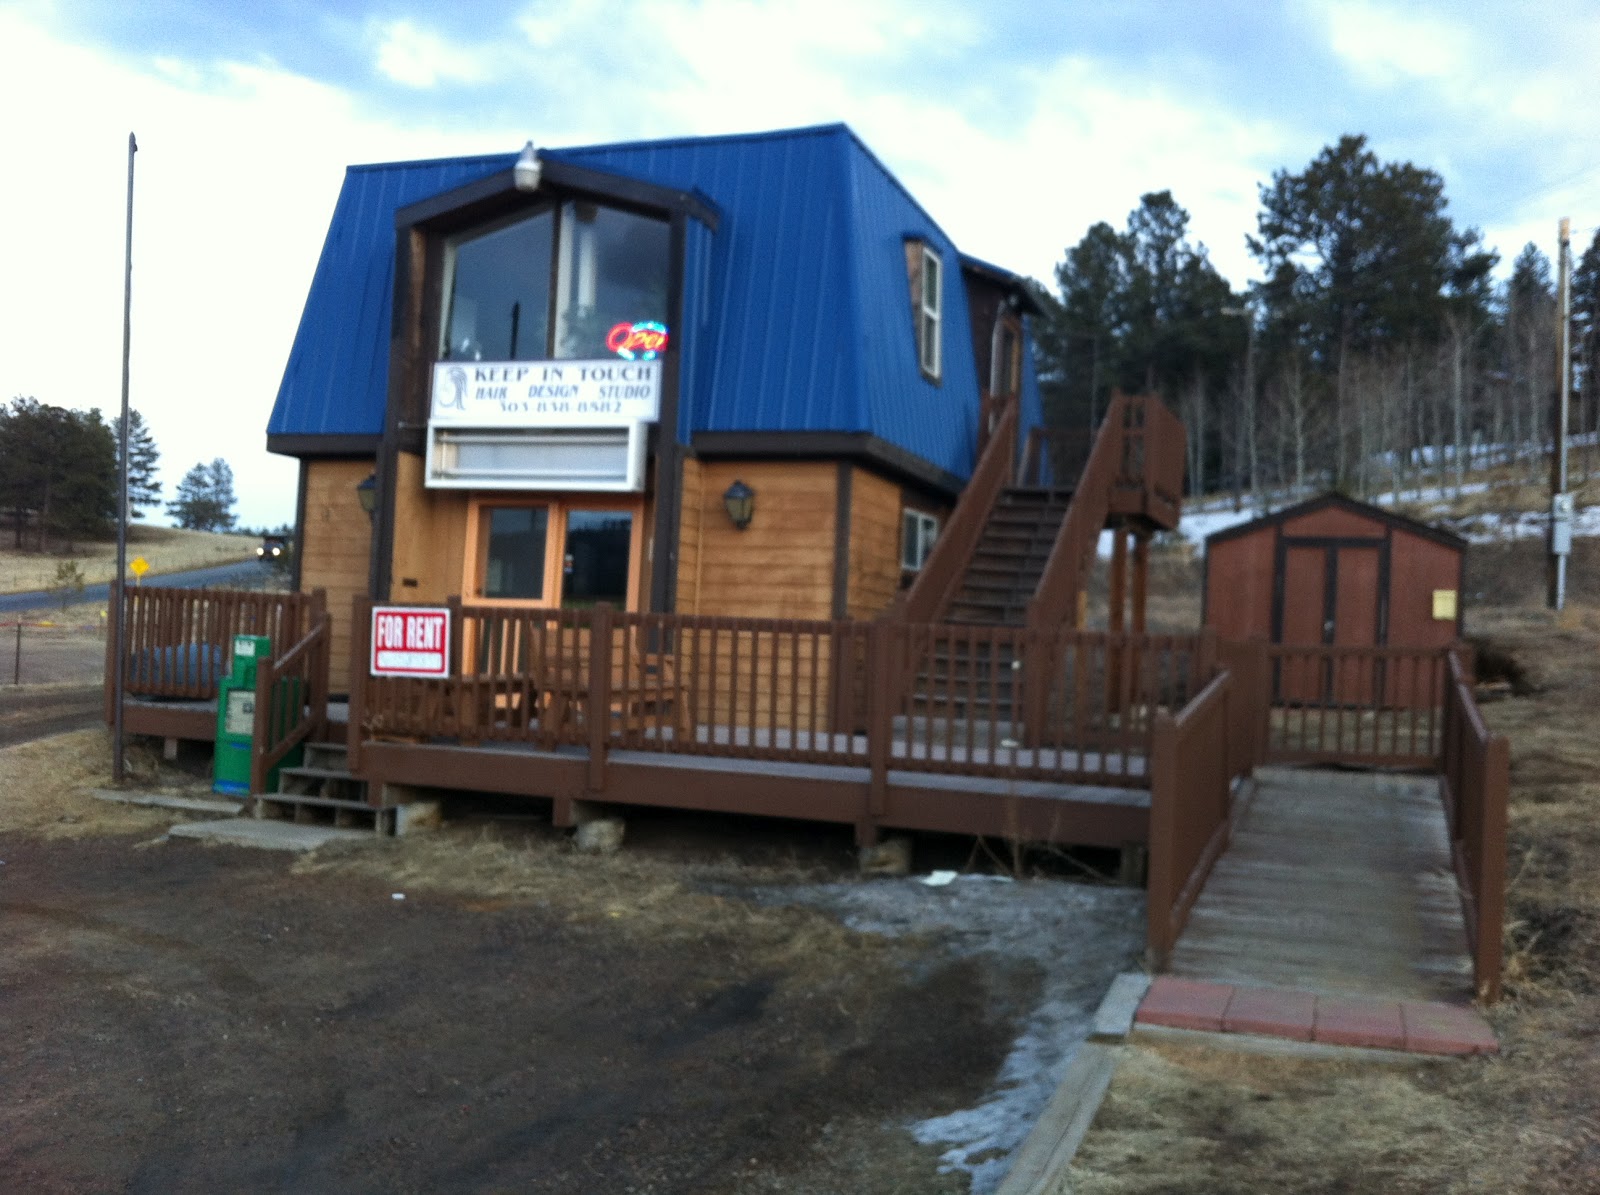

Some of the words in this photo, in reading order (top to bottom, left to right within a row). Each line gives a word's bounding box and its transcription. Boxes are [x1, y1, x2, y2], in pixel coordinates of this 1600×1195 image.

[474, 367, 529, 382] KEEP
[542, 367, 563, 381] IN
[580, 366, 652, 382] TOUCH
[475, 387, 508, 400] HAIR
[528, 385, 580, 398] DESIGN
[599, 385, 651, 399] STUDIO
[377, 615, 403, 649] FOR
[406, 615, 443, 650] RENT
